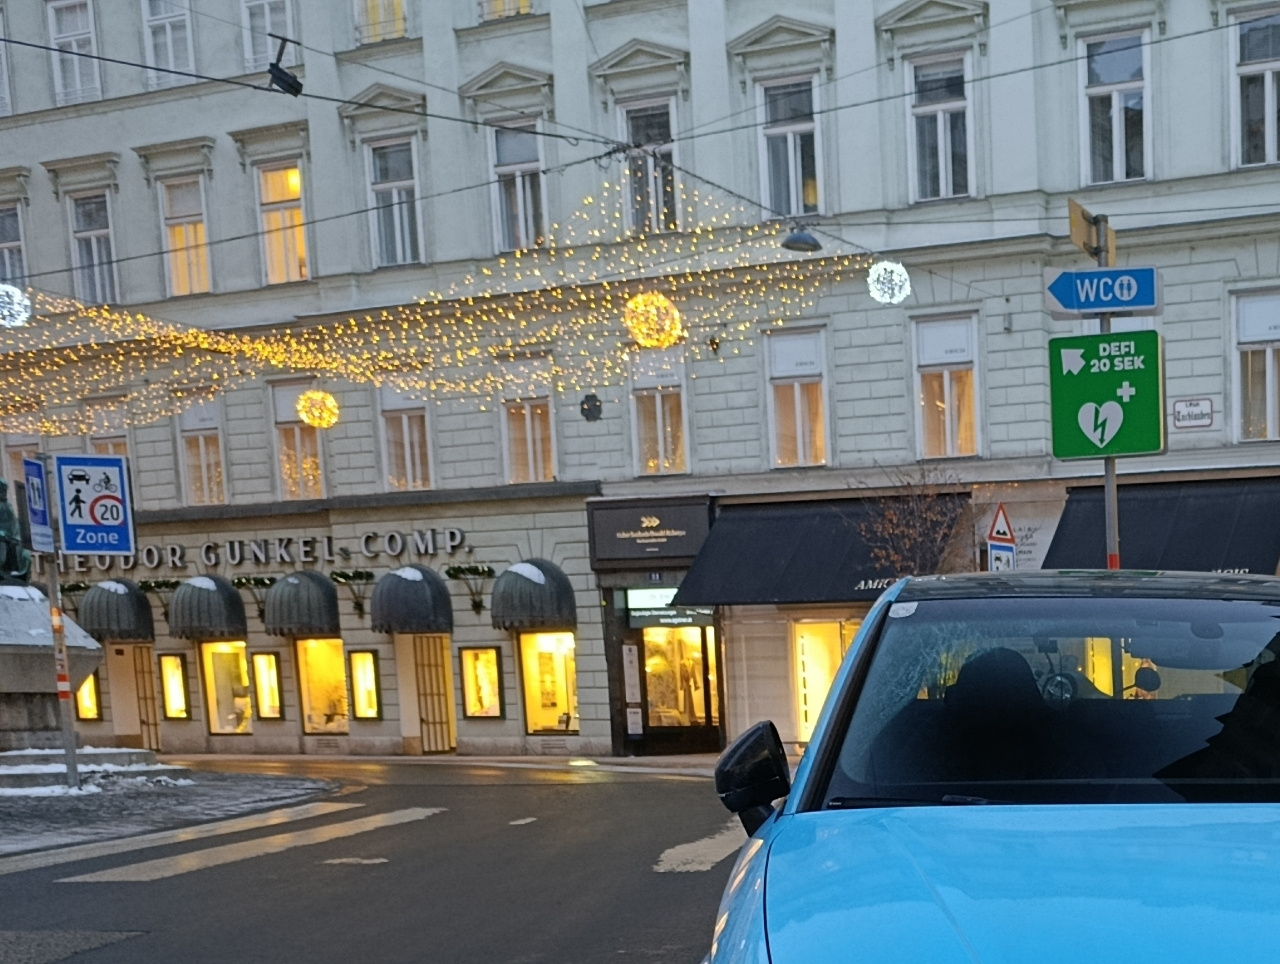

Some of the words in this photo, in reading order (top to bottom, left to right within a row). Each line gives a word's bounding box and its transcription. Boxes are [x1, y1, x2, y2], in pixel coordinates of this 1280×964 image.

[1076, 277, 1113, 303] WC
[1099, 341, 1135, 357] DEFI
[1090, 358, 1110, 373] 20
[1114, 355, 1145, 371] SEK
[100, 503, 120, 521] 20
[75, 528, 119, 545] Zone
[201, 536, 337, 567] GUNKEL
[360, 528, 473, 558] COMP.
